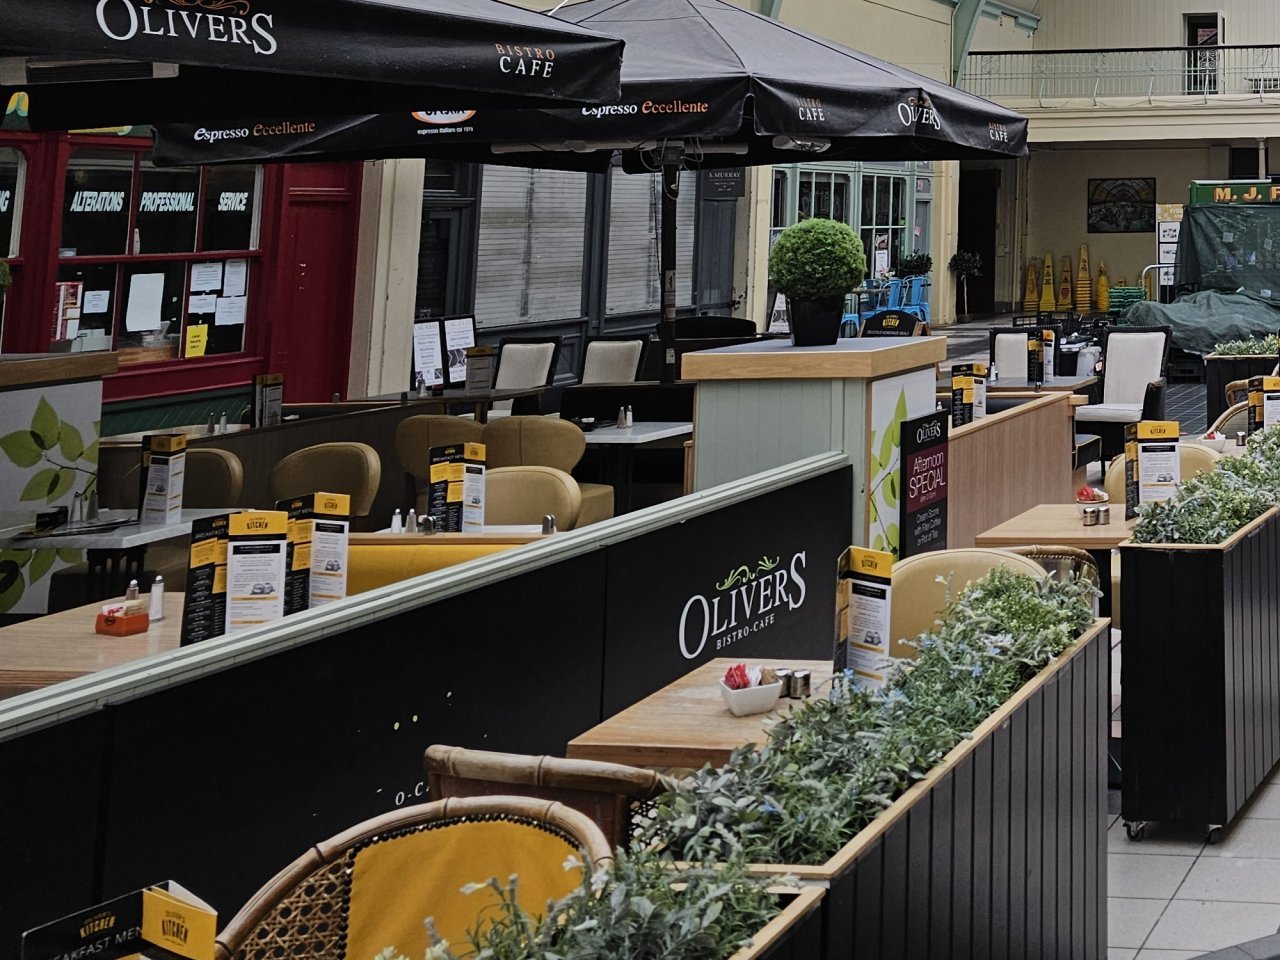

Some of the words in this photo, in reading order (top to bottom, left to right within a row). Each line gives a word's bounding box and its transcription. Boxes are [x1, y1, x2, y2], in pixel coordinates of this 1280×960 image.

[495, 43, 556, 60] BISTRO
[499, 56, 554, 78] CAFE
[799, 107, 825, 121] CAFE
[193, 126, 249, 143] espresso
[253, 121, 316, 137] eccellente
[989, 129, 1008, 142] CAFE
[70, 191, 125, 212] ALTERATIONS
[139, 192, 195, 212] PROFESSIONAL
[217, 192, 249, 212] SERVICE
[1215, 187, 1238, 202] M.
[1243, 187, 1262, 201] J.
[916, 422, 940, 443] OLIVERS
[913, 452, 944, 475] Afternoon
[910, 467, 946, 498] SPECIAL
[678, 550, 806, 659] OLIVERS
[716, 613, 775, 650] BISTRO-CAFE
[79, 916, 116, 939] KITCHEN
[161, 918, 189, 945] KITCHEN
